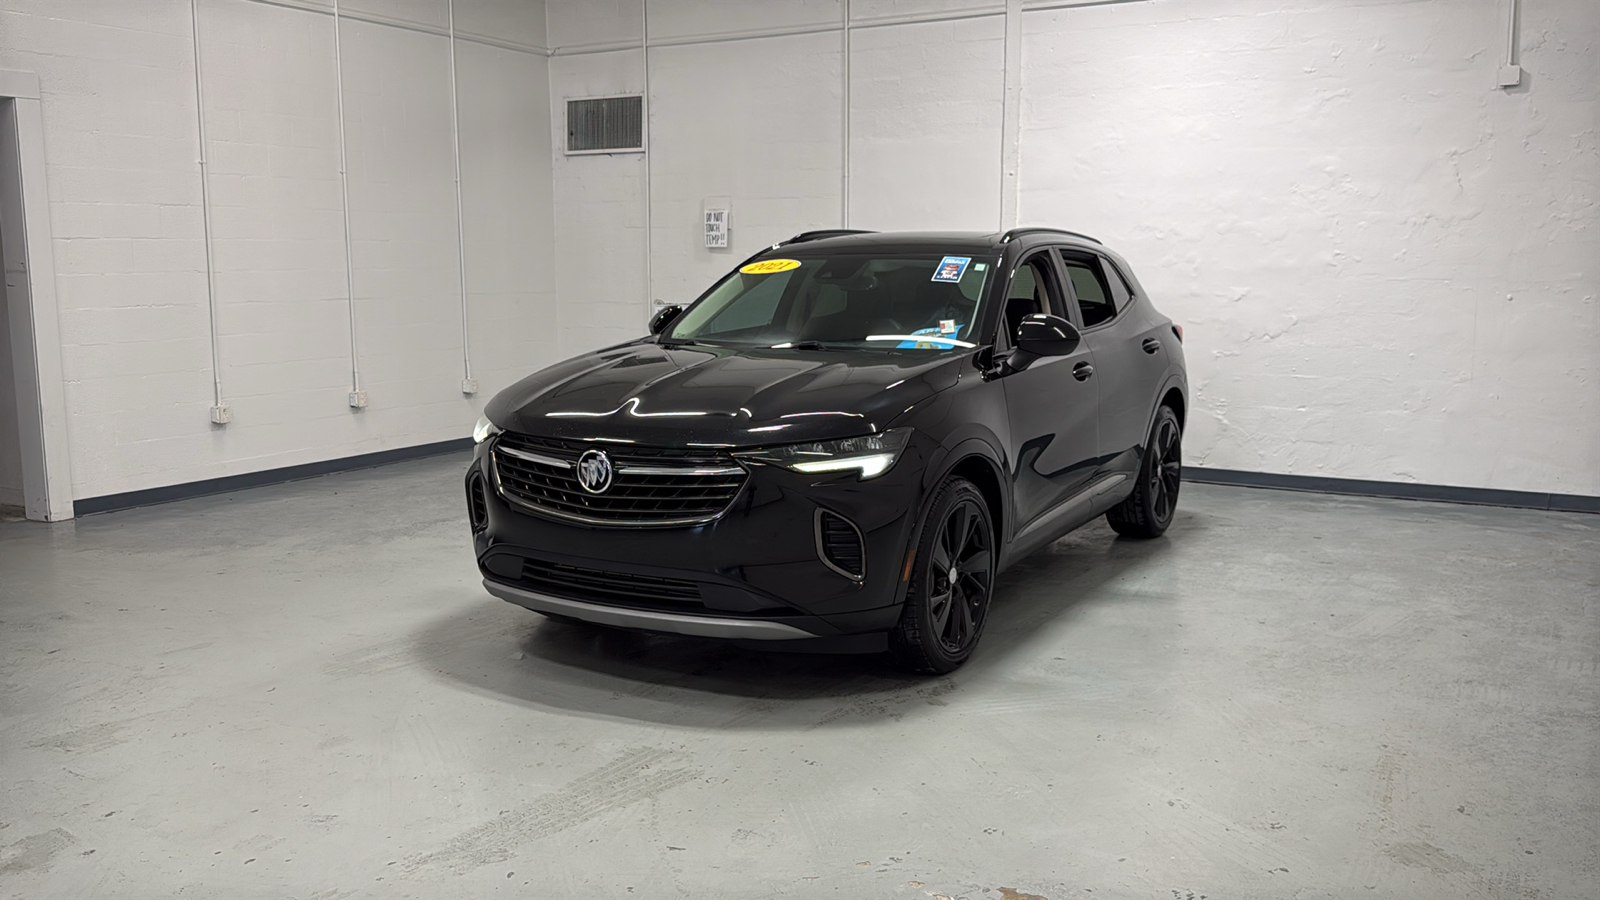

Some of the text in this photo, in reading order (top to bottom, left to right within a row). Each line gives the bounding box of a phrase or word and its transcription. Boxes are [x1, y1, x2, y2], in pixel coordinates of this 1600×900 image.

[706, 211, 724, 223] DO NOT
[706, 223, 720, 233] TOUCH
[745, 261, 792, 271] 2021
